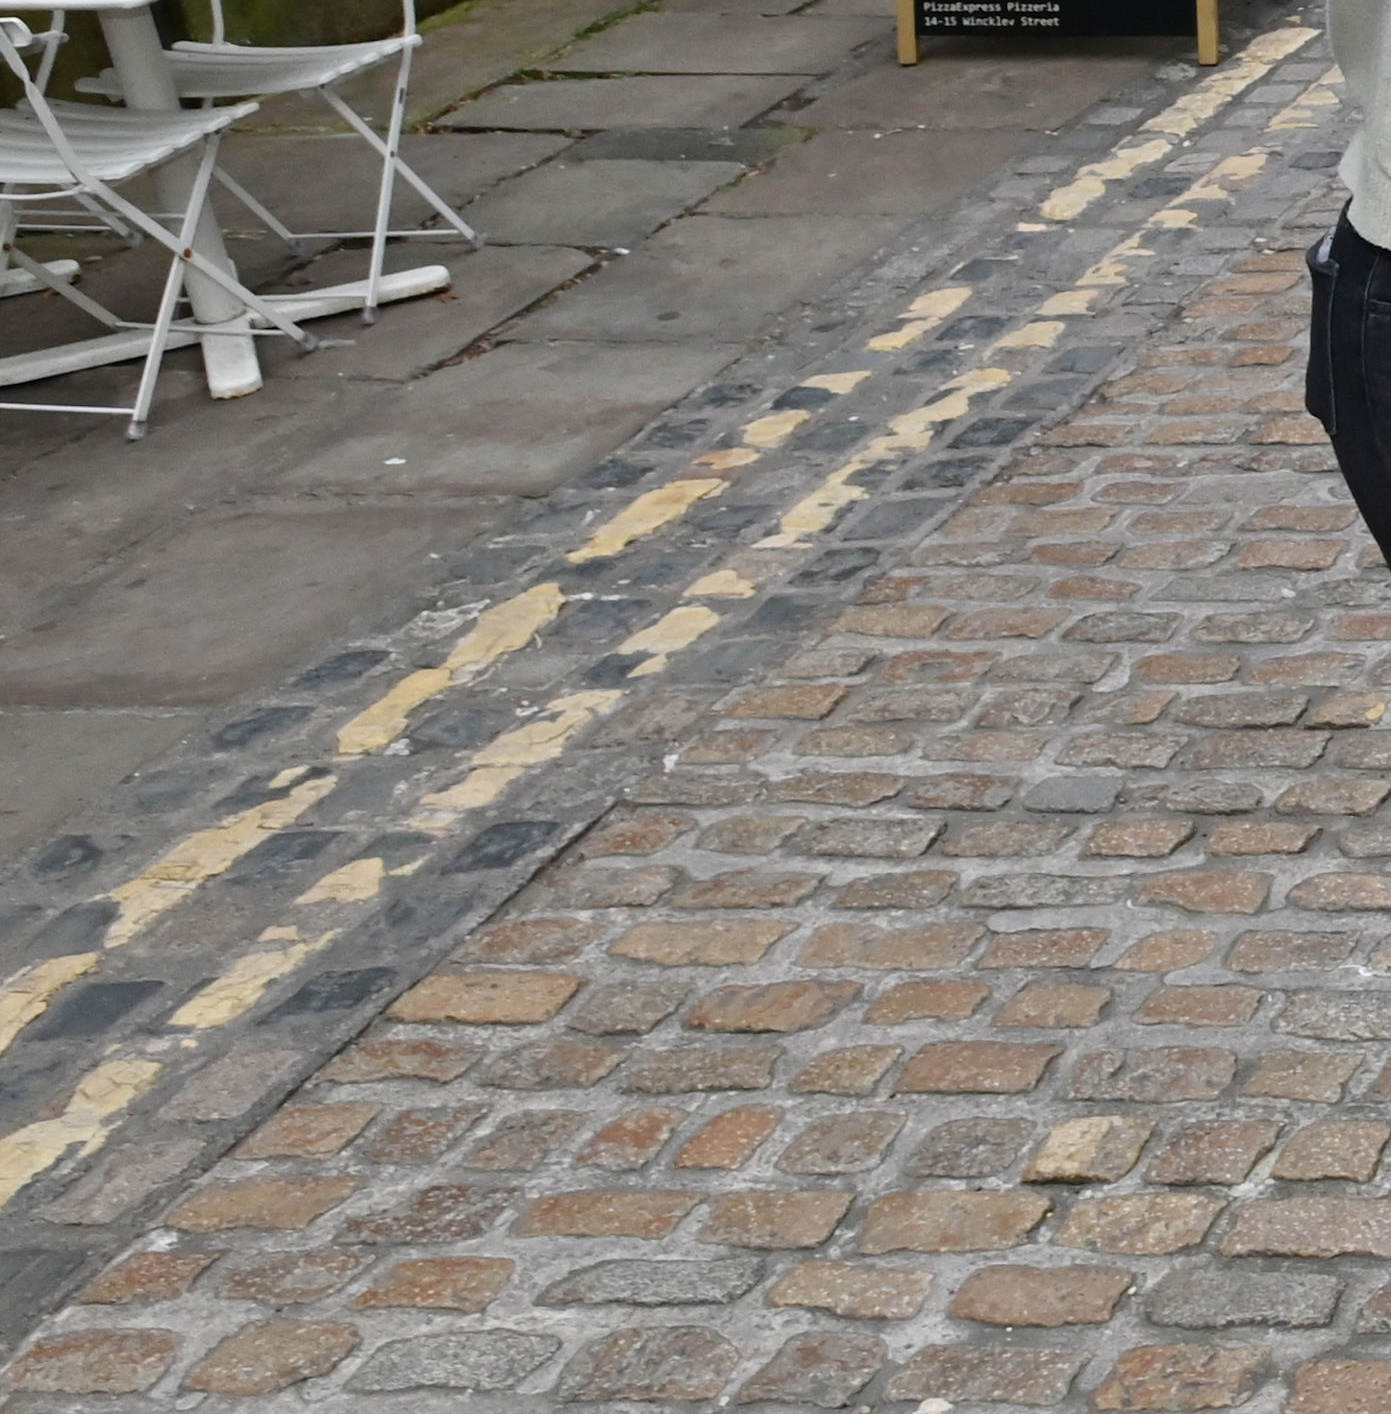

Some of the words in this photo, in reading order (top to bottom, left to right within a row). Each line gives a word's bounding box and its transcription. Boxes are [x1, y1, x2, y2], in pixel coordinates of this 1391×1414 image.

[923, 2, 1001, 14] PizzaExpress
[1007, 2, 1060, 12] Pizzeria
[925, 16, 957, 26] 14-15
[1020, 16, 1060, 26] Street
